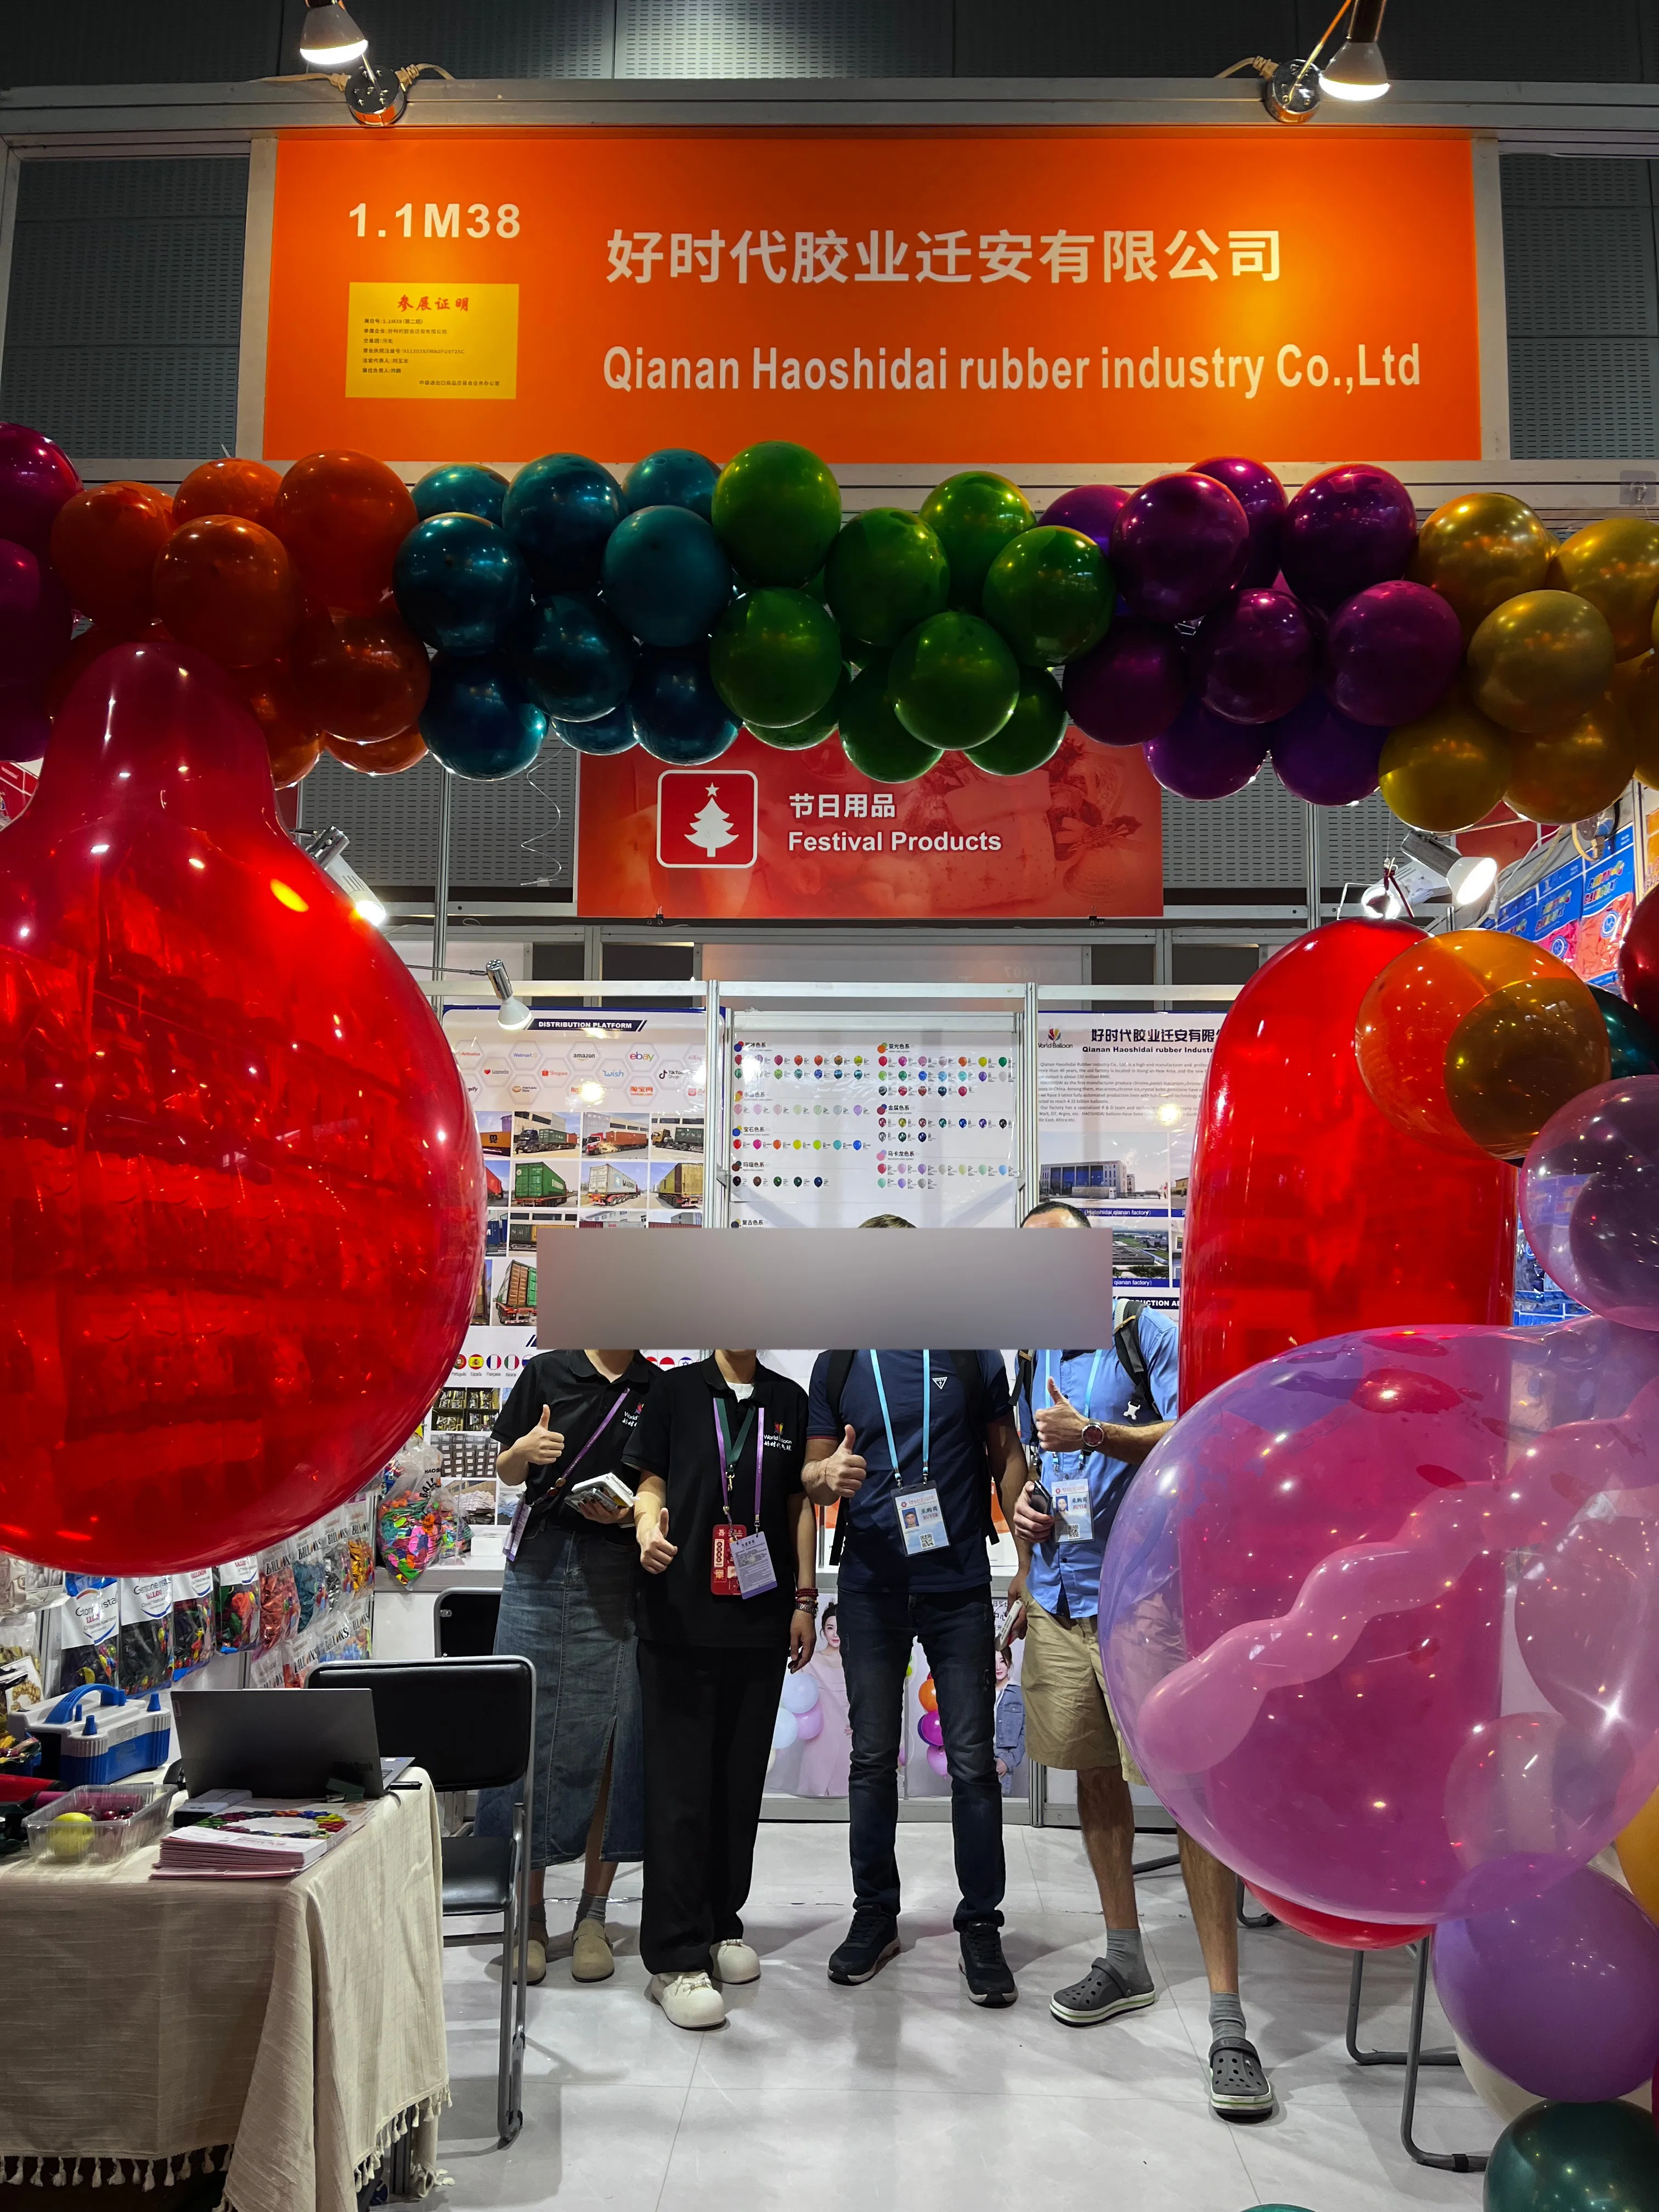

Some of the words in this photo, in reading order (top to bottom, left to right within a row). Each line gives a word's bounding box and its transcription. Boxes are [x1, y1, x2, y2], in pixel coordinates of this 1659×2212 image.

[348, 202, 521, 239] 1.1M38
[606, 228, 1279, 284] 好时代胶业迁安有限公司
[397, 294, 470, 312] 参展证明
[604, 346, 739, 392] Qianan
[753, 347, 946, 391] Haoshidai
[961, 347, 1090, 390] rubber
[1102, 345, 1265, 399] industry
[1277, 342, 1421, 394] Co.,Ltd
[788, 793, 895, 819] 节日用品
[788, 831, 882, 852] Festival
[892, 831, 1002, 852] Products
[1091, 1029, 1220, 1042] 好时代胶业迁安有限
[630, 1051, 654, 1062] ebay
